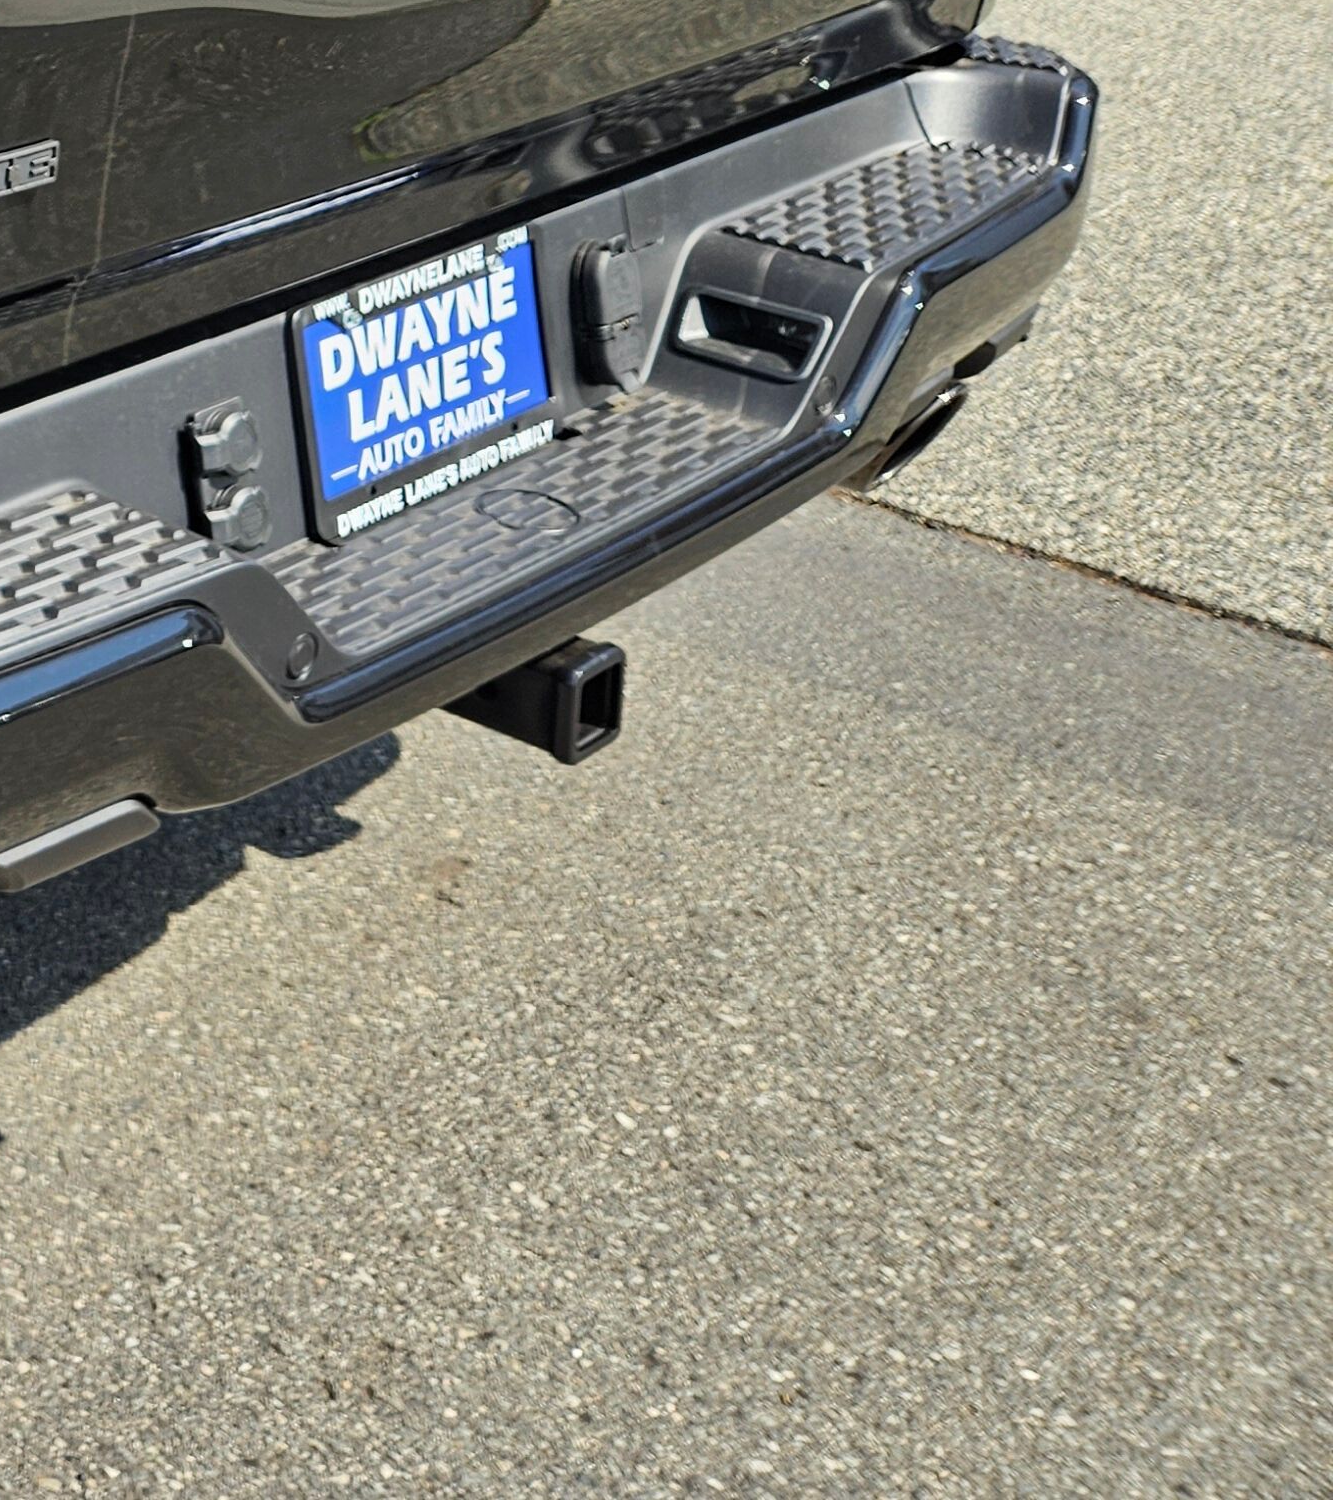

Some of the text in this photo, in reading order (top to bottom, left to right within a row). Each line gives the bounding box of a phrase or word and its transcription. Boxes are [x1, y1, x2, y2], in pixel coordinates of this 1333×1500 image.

[319, 266, 517, 392] DWAYNE
[348, 331, 506, 443] LANE'S
[336, 419, 554, 539] DWAYNE LANE'S AUTO FAMILY
[358, 389, 506, 481] AUTO FAMILY
